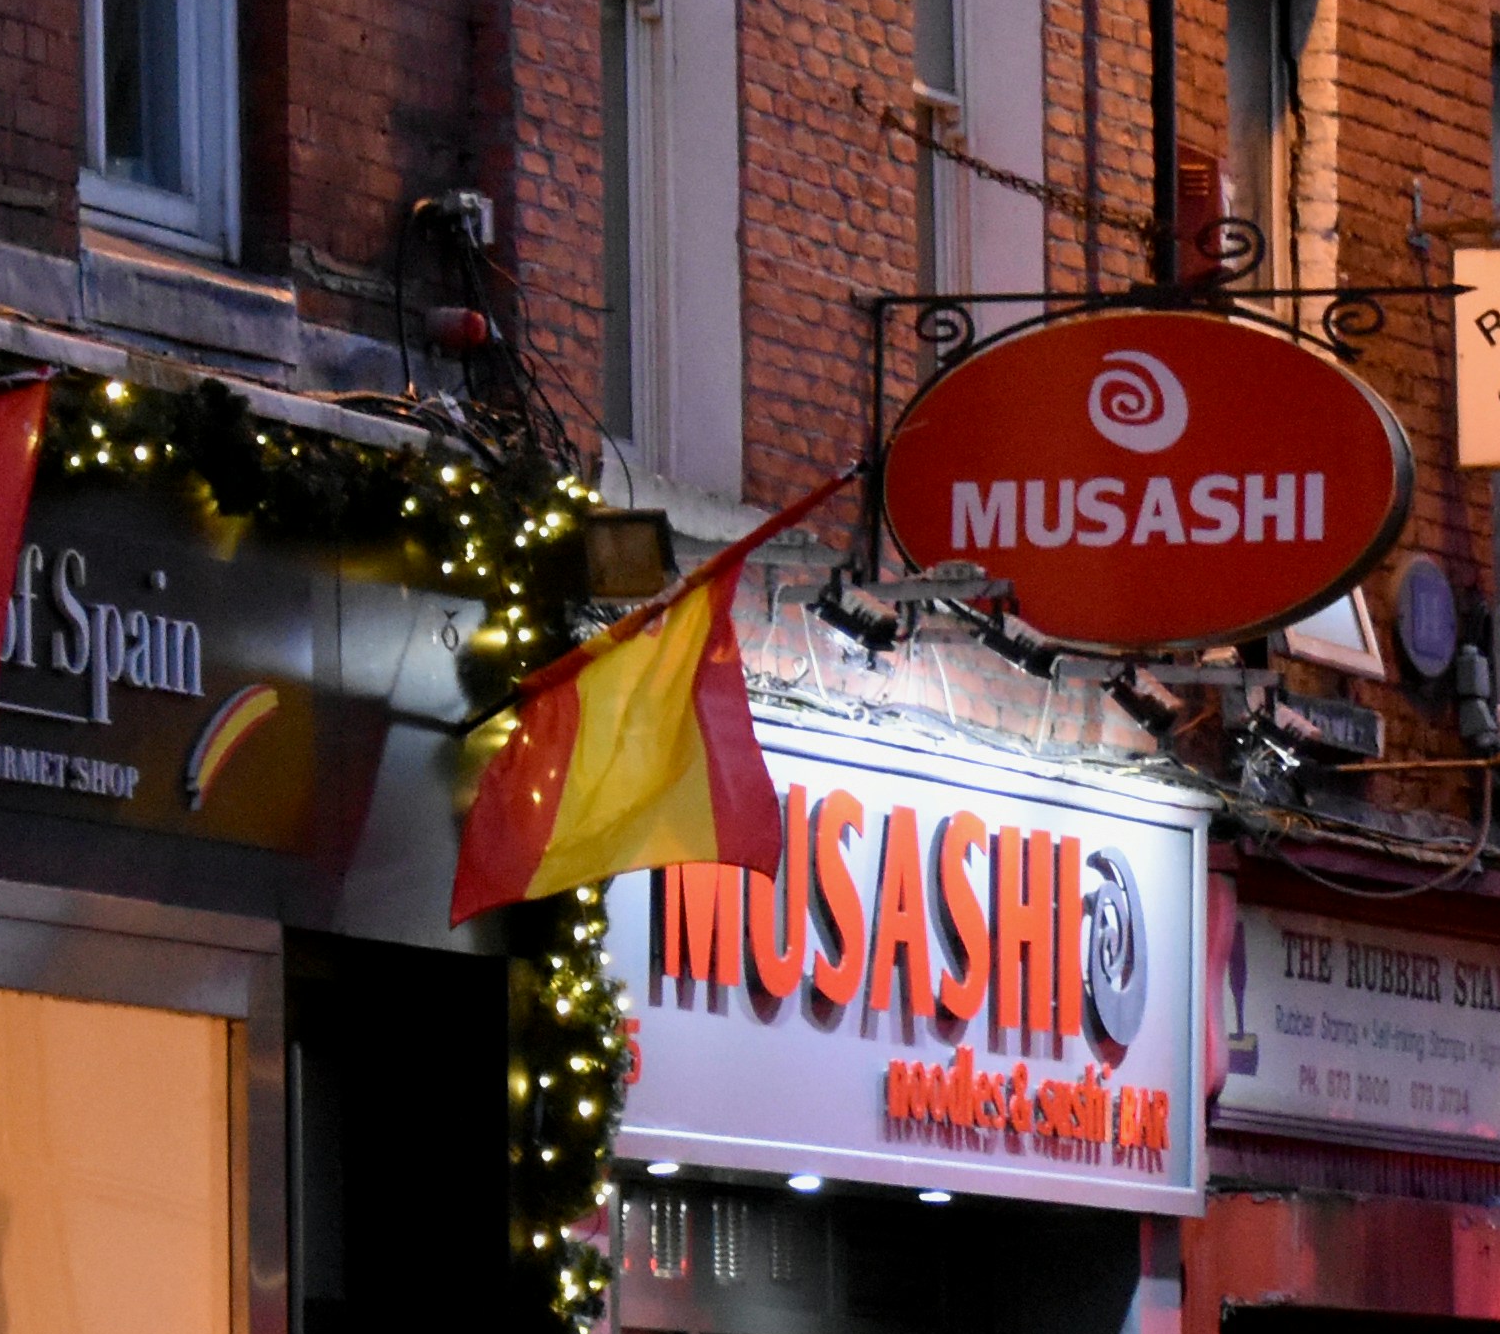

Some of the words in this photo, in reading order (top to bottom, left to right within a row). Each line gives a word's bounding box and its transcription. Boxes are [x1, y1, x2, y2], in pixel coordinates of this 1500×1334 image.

[951, 471, 1325, 550] MUSASHI
[52, 548, 204, 725] Spain
[69, 757, 139, 799] SHOP
[663, 782, 1082, 1037] MUSASHI
[1282, 929, 1332, 984] THE
[1345, 938, 1441, 1004] RUBBER
[888, 1044, 1005, 1130] noodles
[1010, 1062, 1033, 1133] &
[1037, 1063, 1112, 1143] sushi
[1119, 1085, 1170, 1150] BAR
